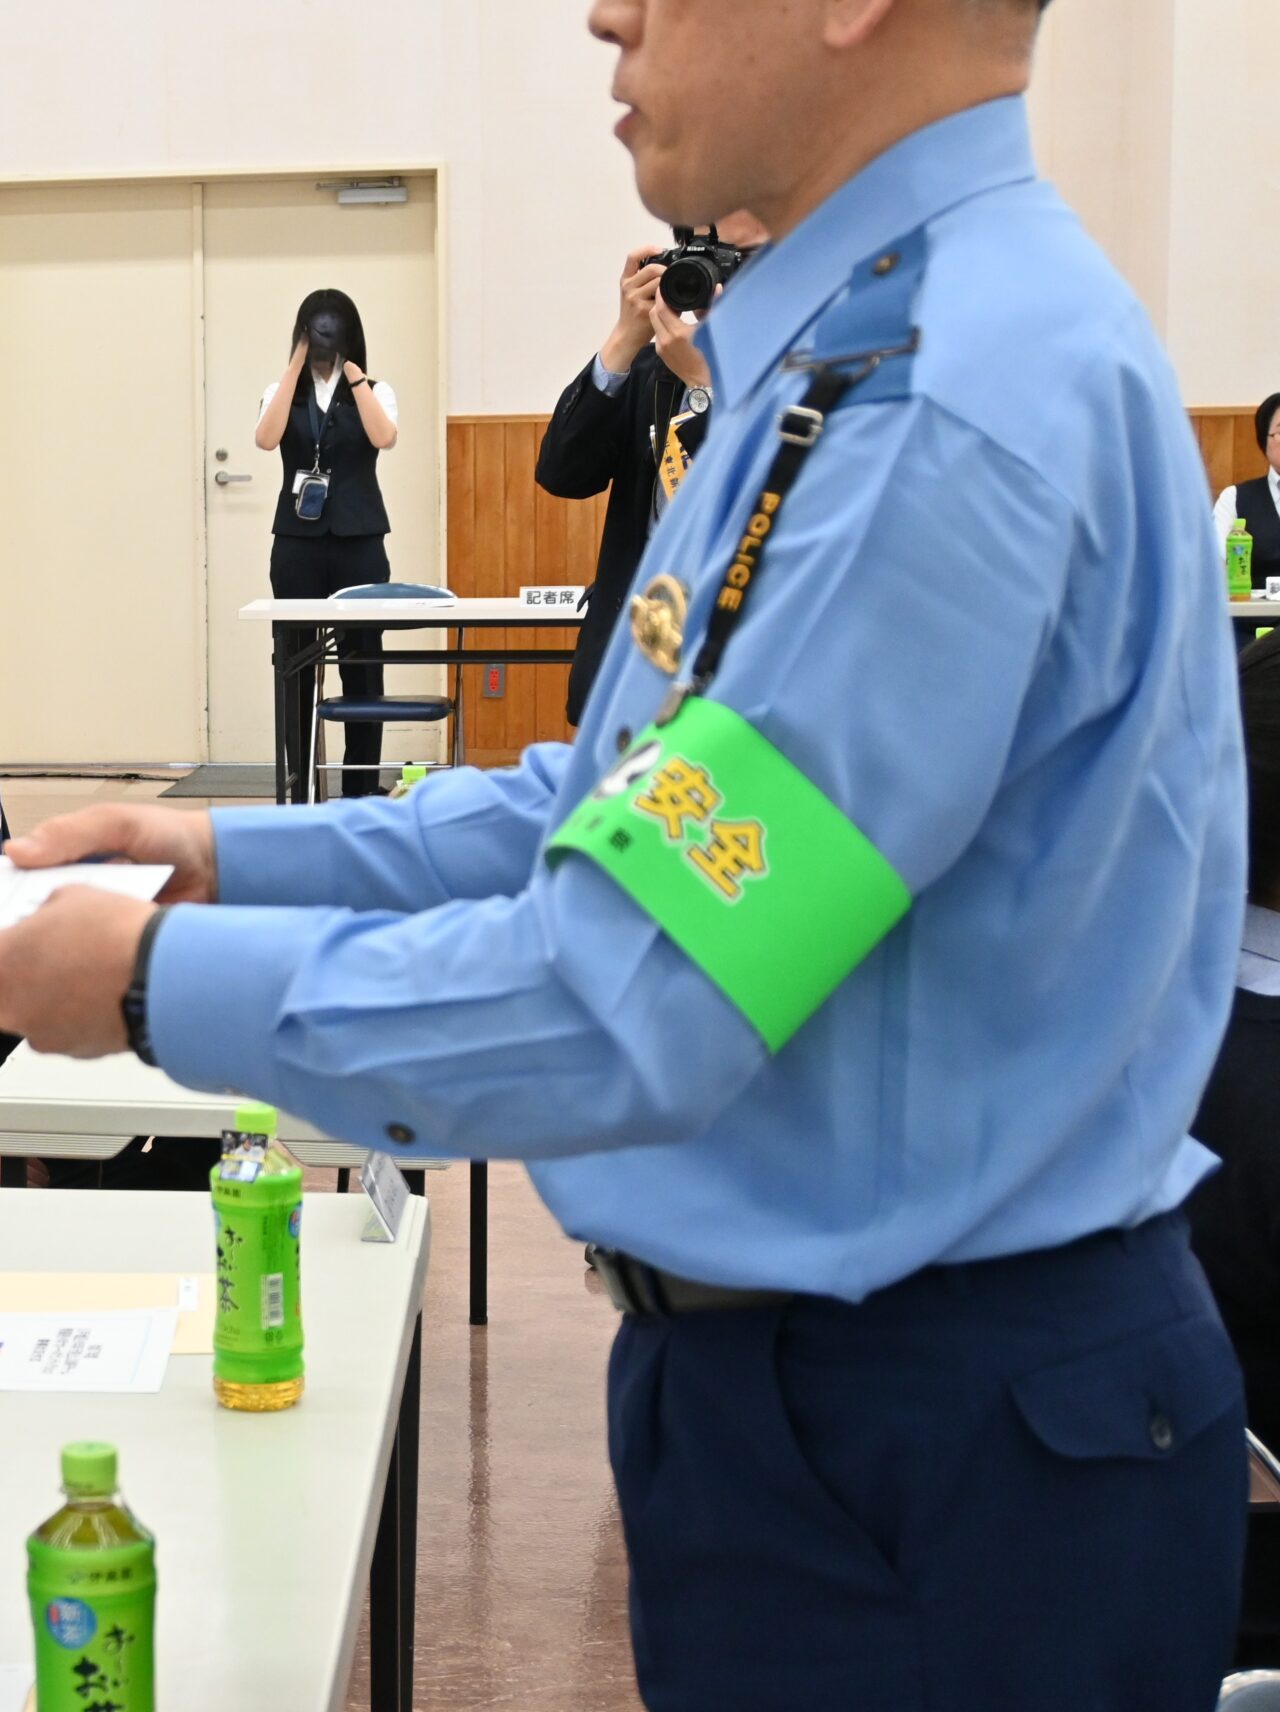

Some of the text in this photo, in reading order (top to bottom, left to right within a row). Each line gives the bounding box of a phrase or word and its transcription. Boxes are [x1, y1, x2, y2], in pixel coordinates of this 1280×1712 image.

[526, 590, 575, 605] 記者席
[717, 492, 782, 612] POLICE
[634, 756, 769, 901] 安全
